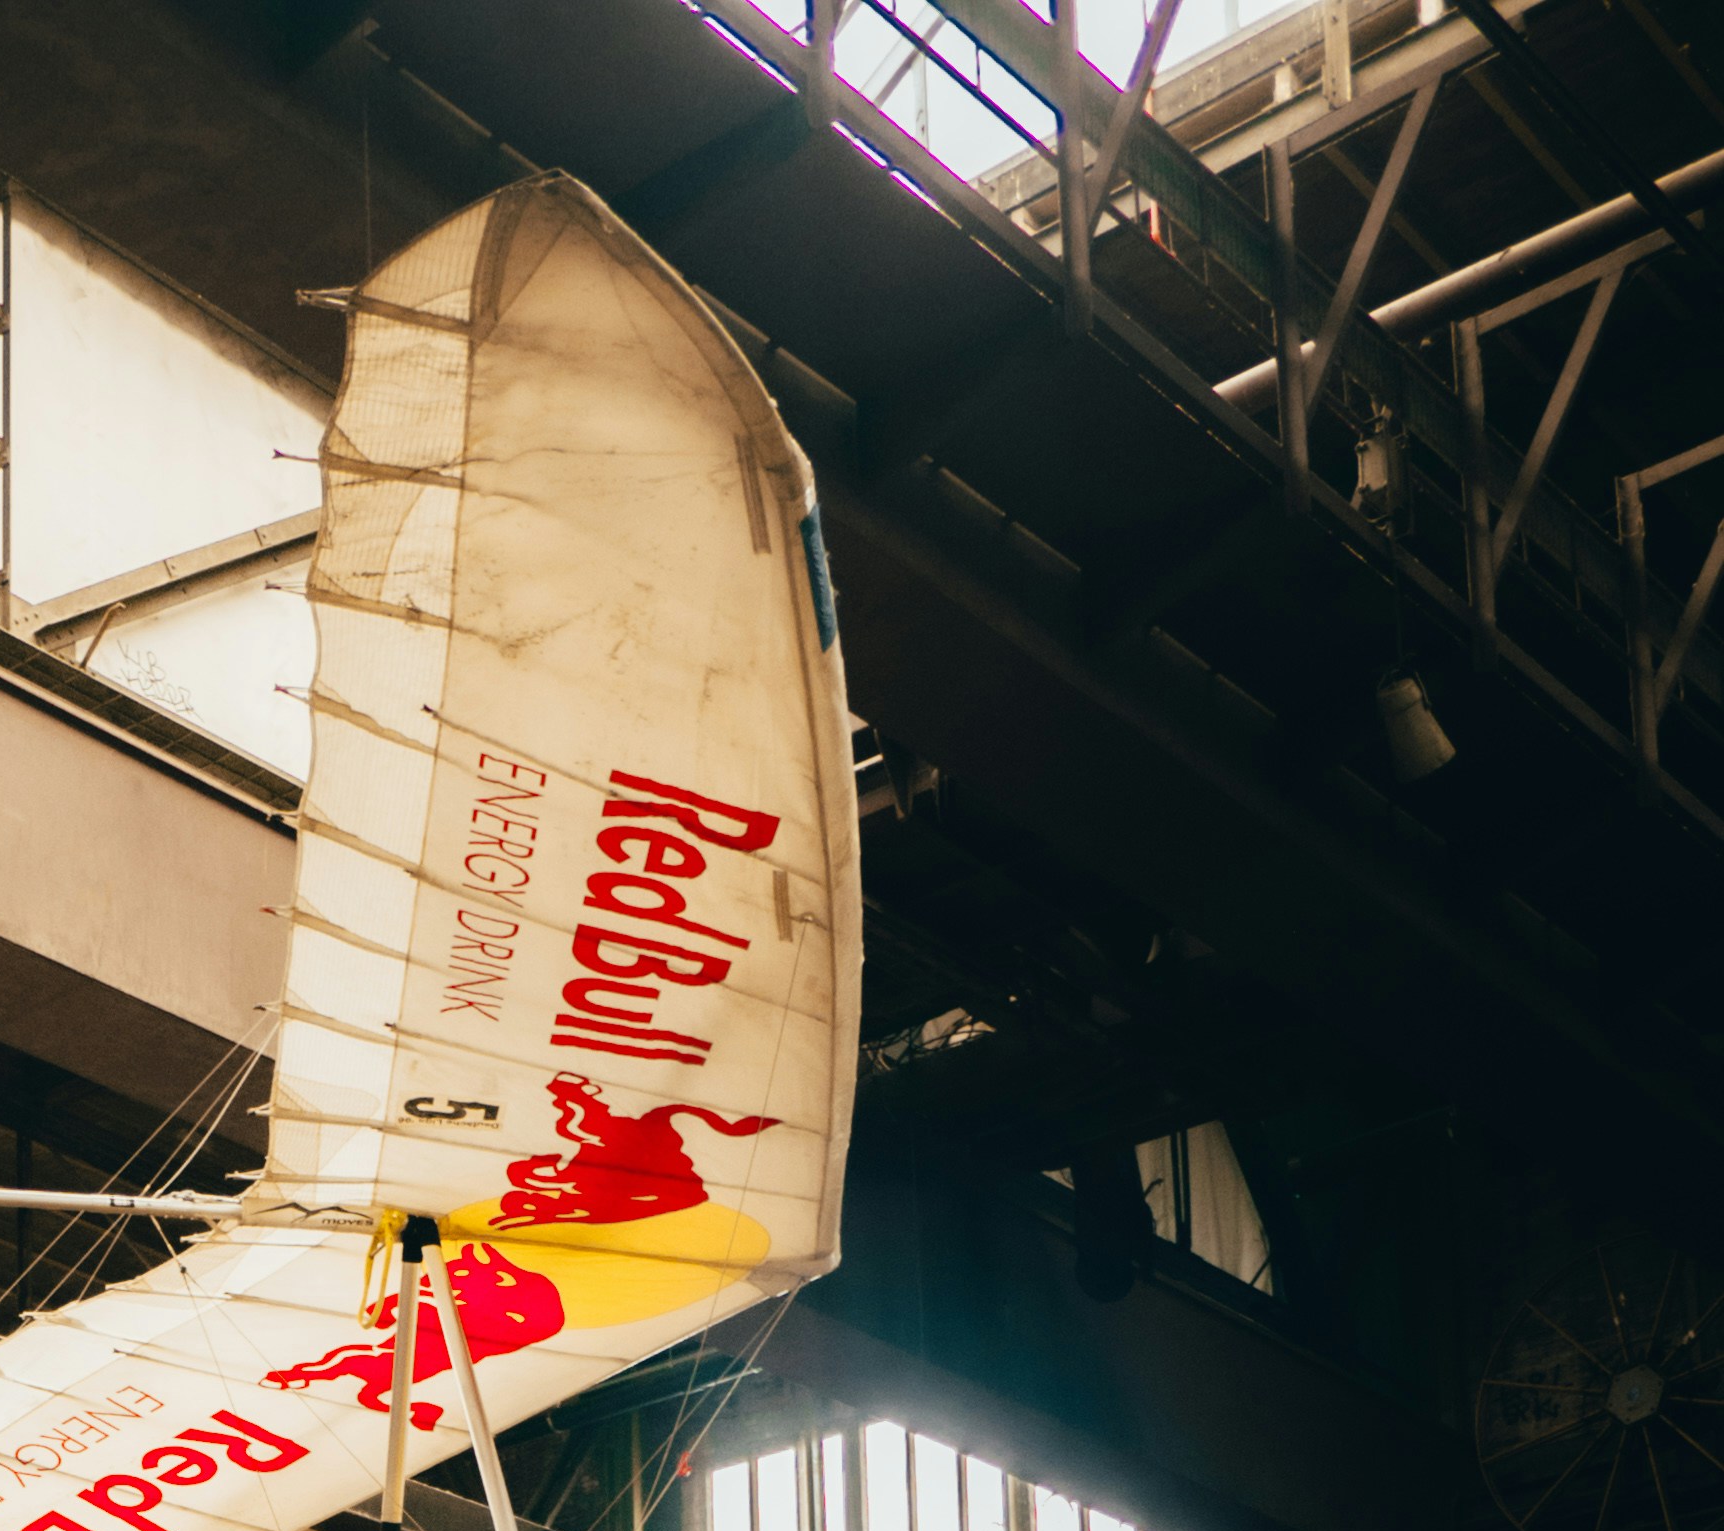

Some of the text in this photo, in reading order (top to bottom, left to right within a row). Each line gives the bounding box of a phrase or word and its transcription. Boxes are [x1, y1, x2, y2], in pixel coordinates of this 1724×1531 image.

[440, 753, 546, 1021] ENERGY DRINK
[404, 1097, 499, 1120] 5
